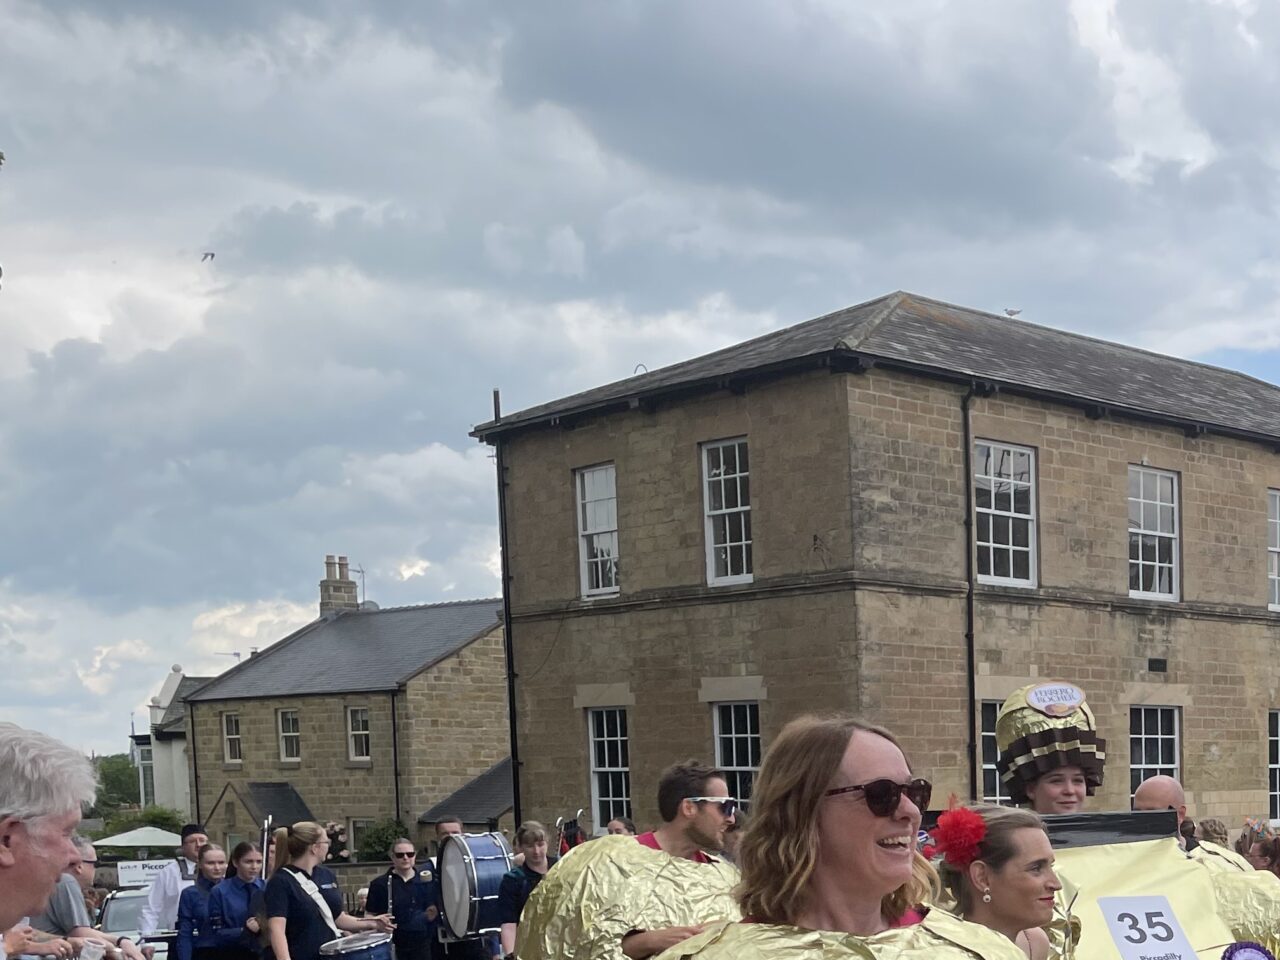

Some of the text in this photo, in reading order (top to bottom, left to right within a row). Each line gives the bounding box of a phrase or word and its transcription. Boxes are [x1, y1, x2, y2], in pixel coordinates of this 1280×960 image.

[1035, 688, 1074, 697] FERRERO
[1036, 694, 1078, 703] ROCHER
[1117, 911, 1174, 944] 35
